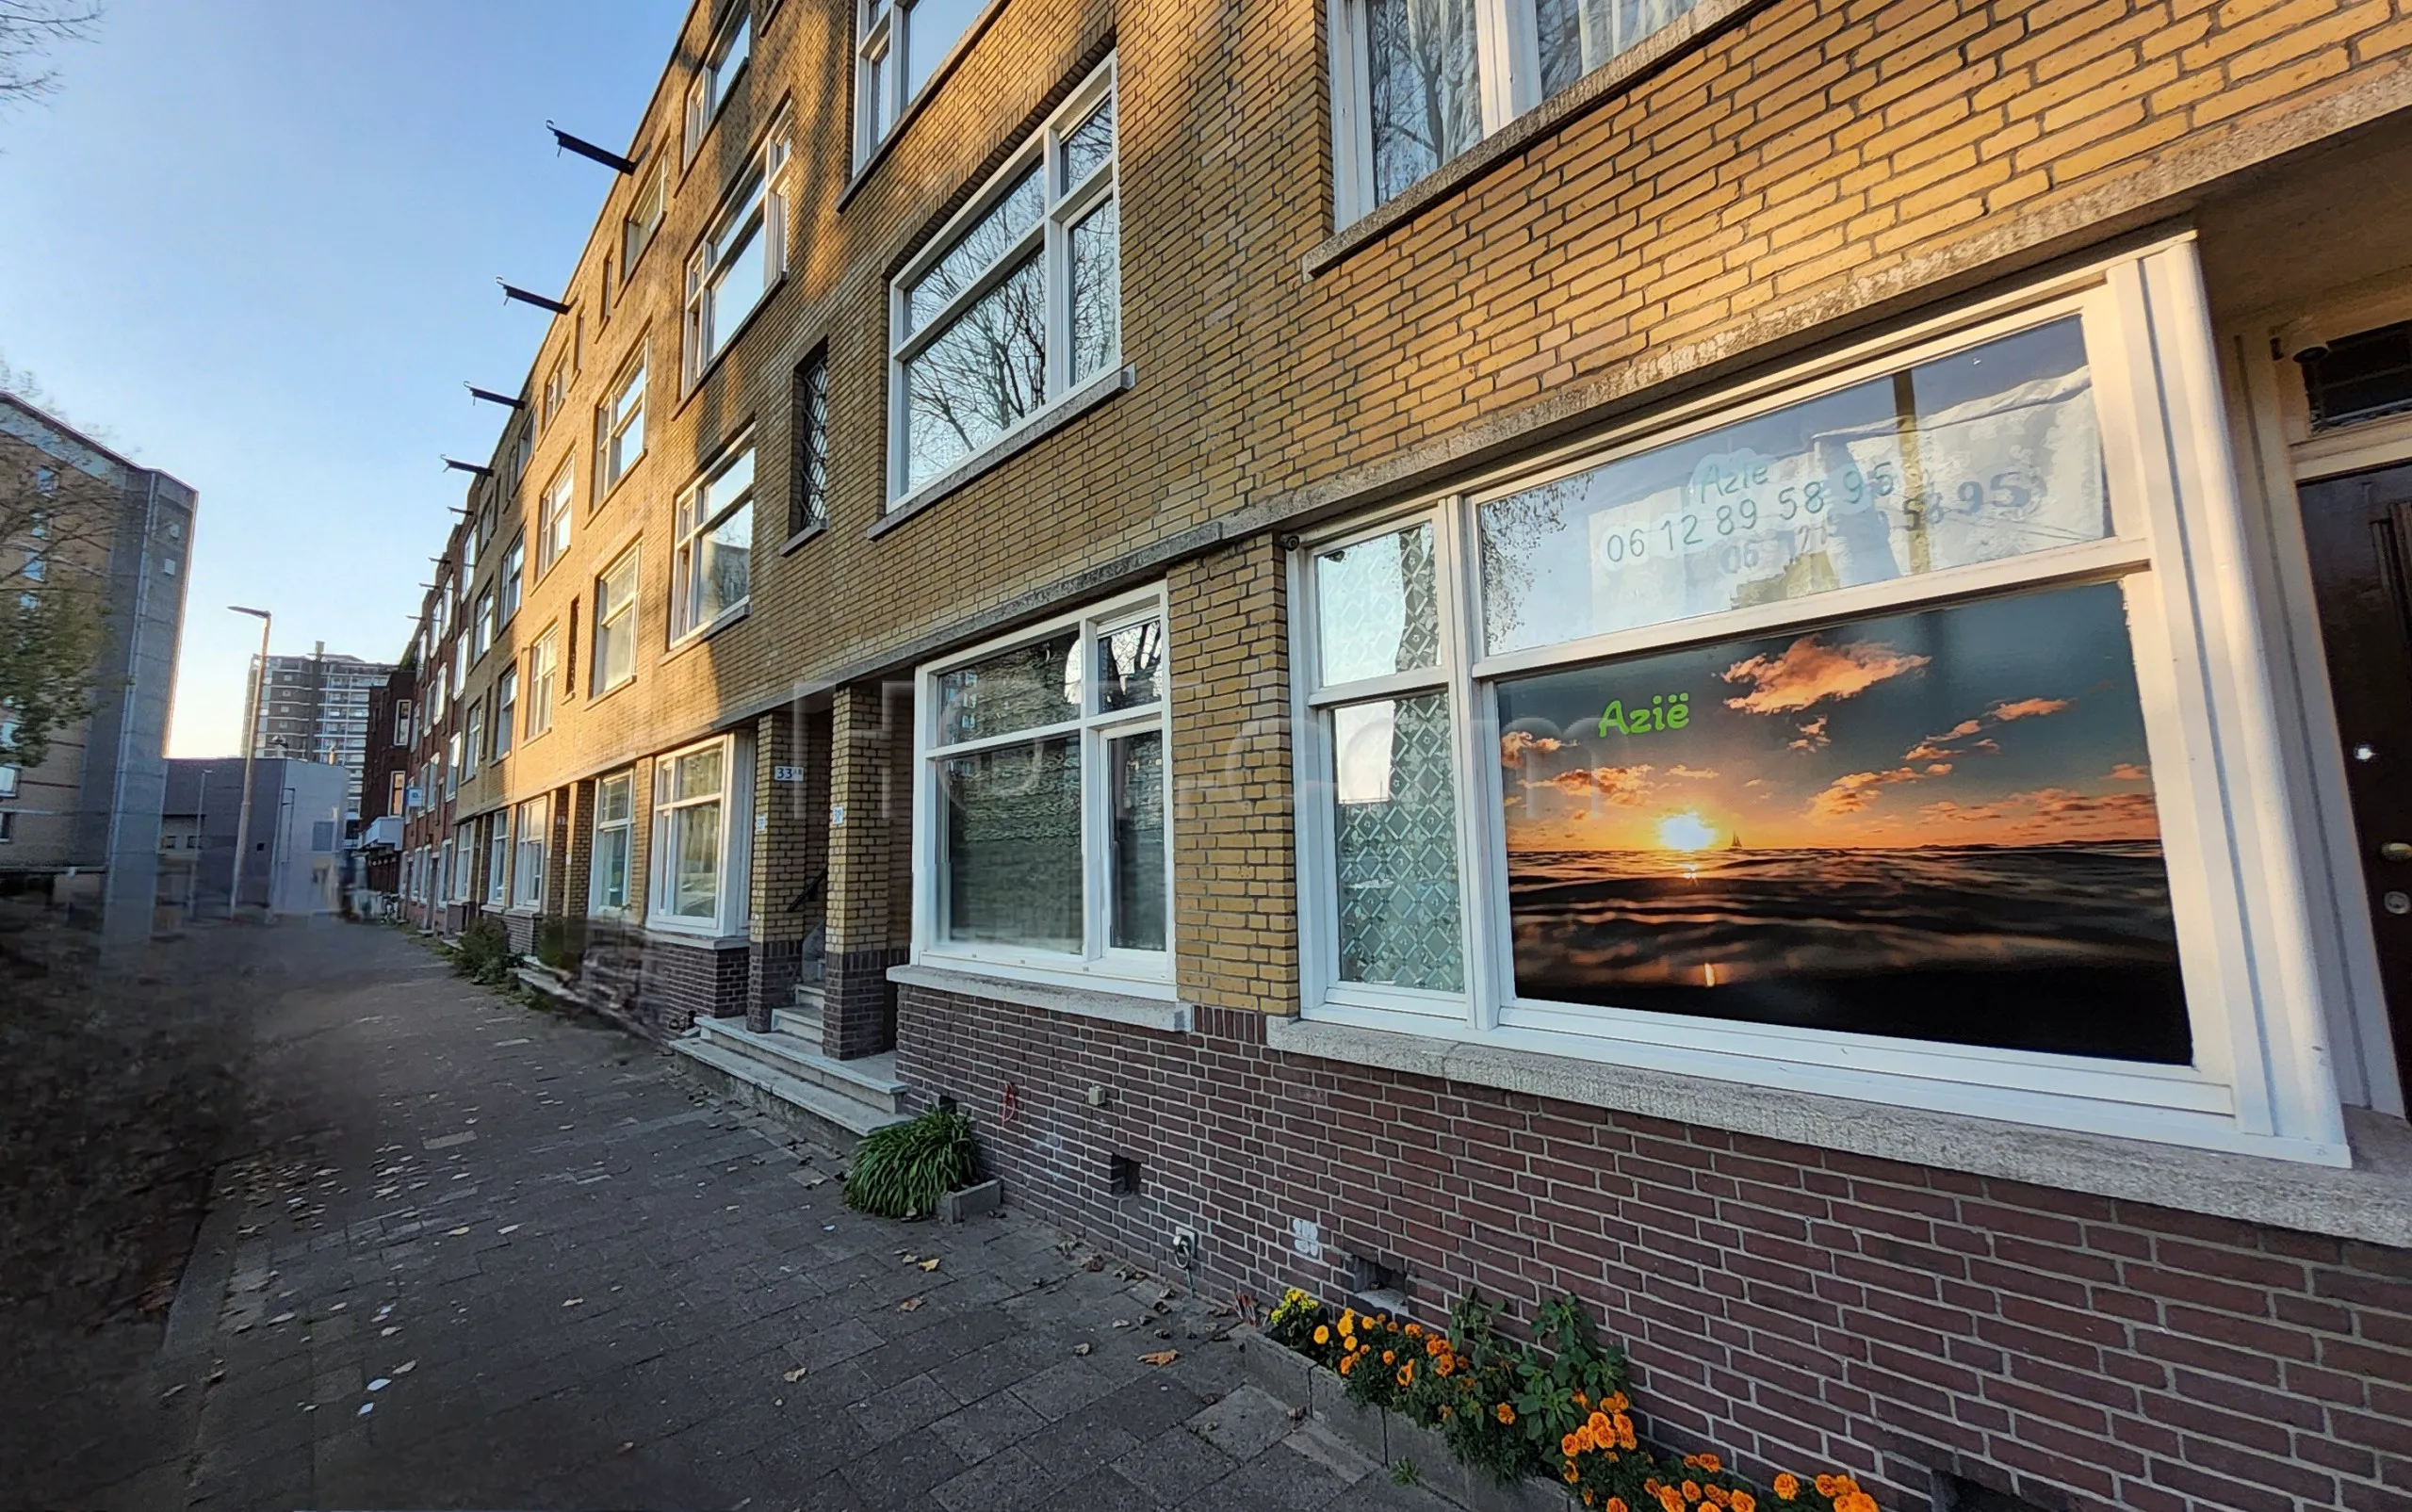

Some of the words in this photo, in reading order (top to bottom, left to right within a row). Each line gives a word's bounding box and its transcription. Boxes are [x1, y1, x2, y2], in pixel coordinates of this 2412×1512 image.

[1606, 528, 1645, 562] 06
[1659, 513, 1704, 552] 12
[1716, 497, 1758, 536] 89
[1778, 480, 1825, 520] 58
[1842, 461, 1895, 505] 95
[1598, 692, 1689, 738] Azië
